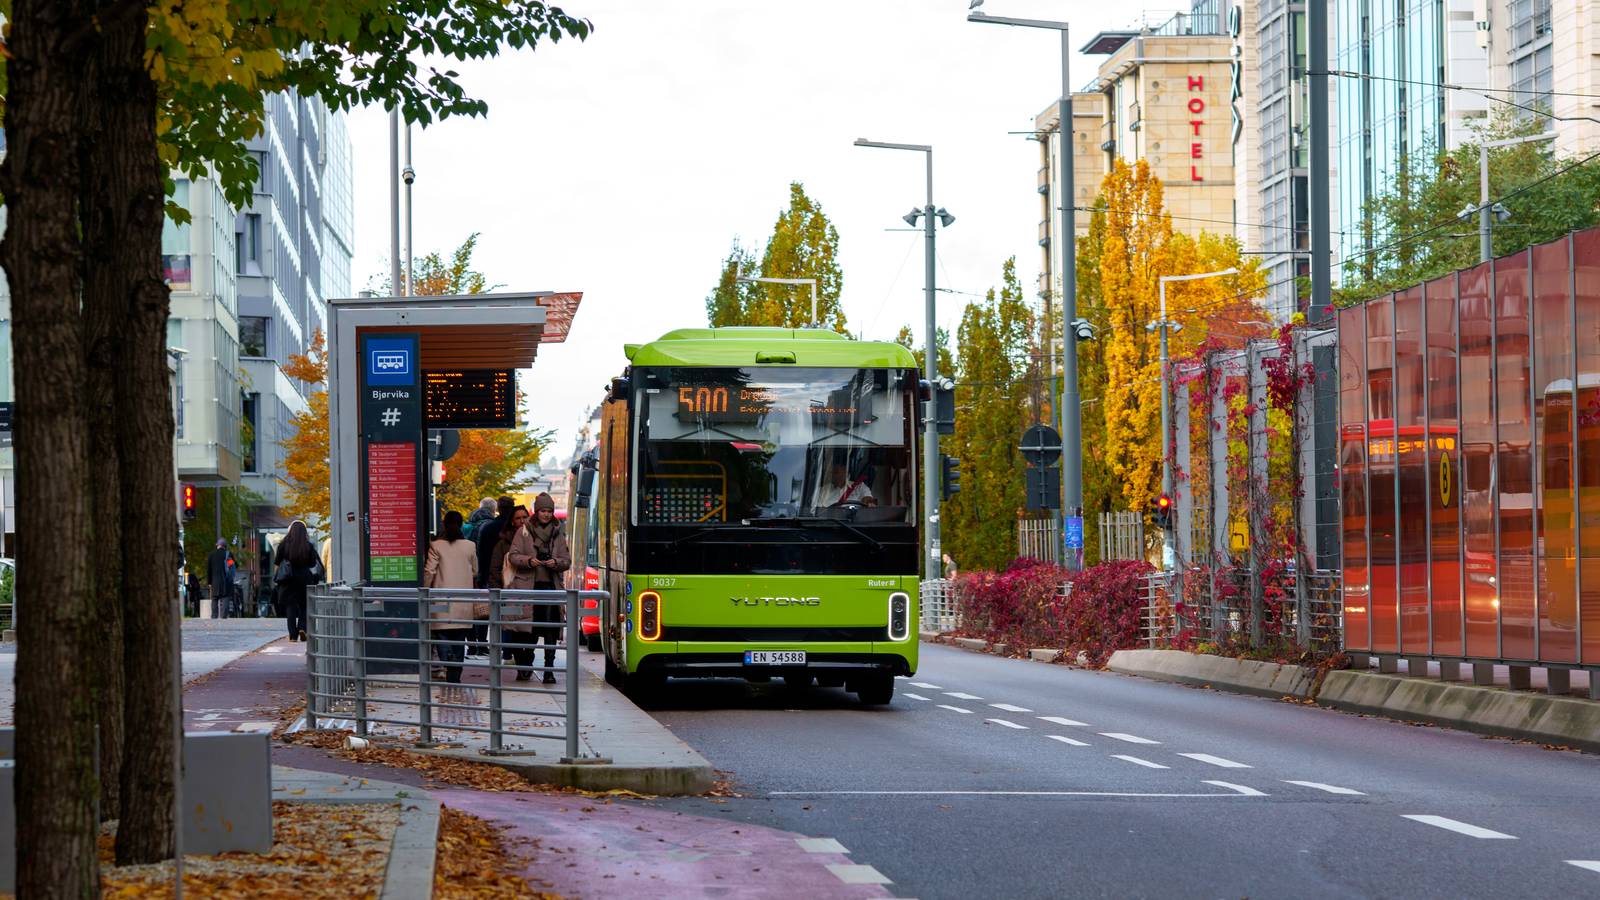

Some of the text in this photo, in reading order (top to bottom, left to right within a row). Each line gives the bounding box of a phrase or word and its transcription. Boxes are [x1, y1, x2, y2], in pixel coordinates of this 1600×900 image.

[1187, 75, 1204, 182] HOTEL
[372, 390, 410, 401] Bjørvika
[653, 578, 896, 587] 9037 Ruter#
[730, 597, 821, 607] YUTONG
[753, 652, 804, 662] EN 54588
